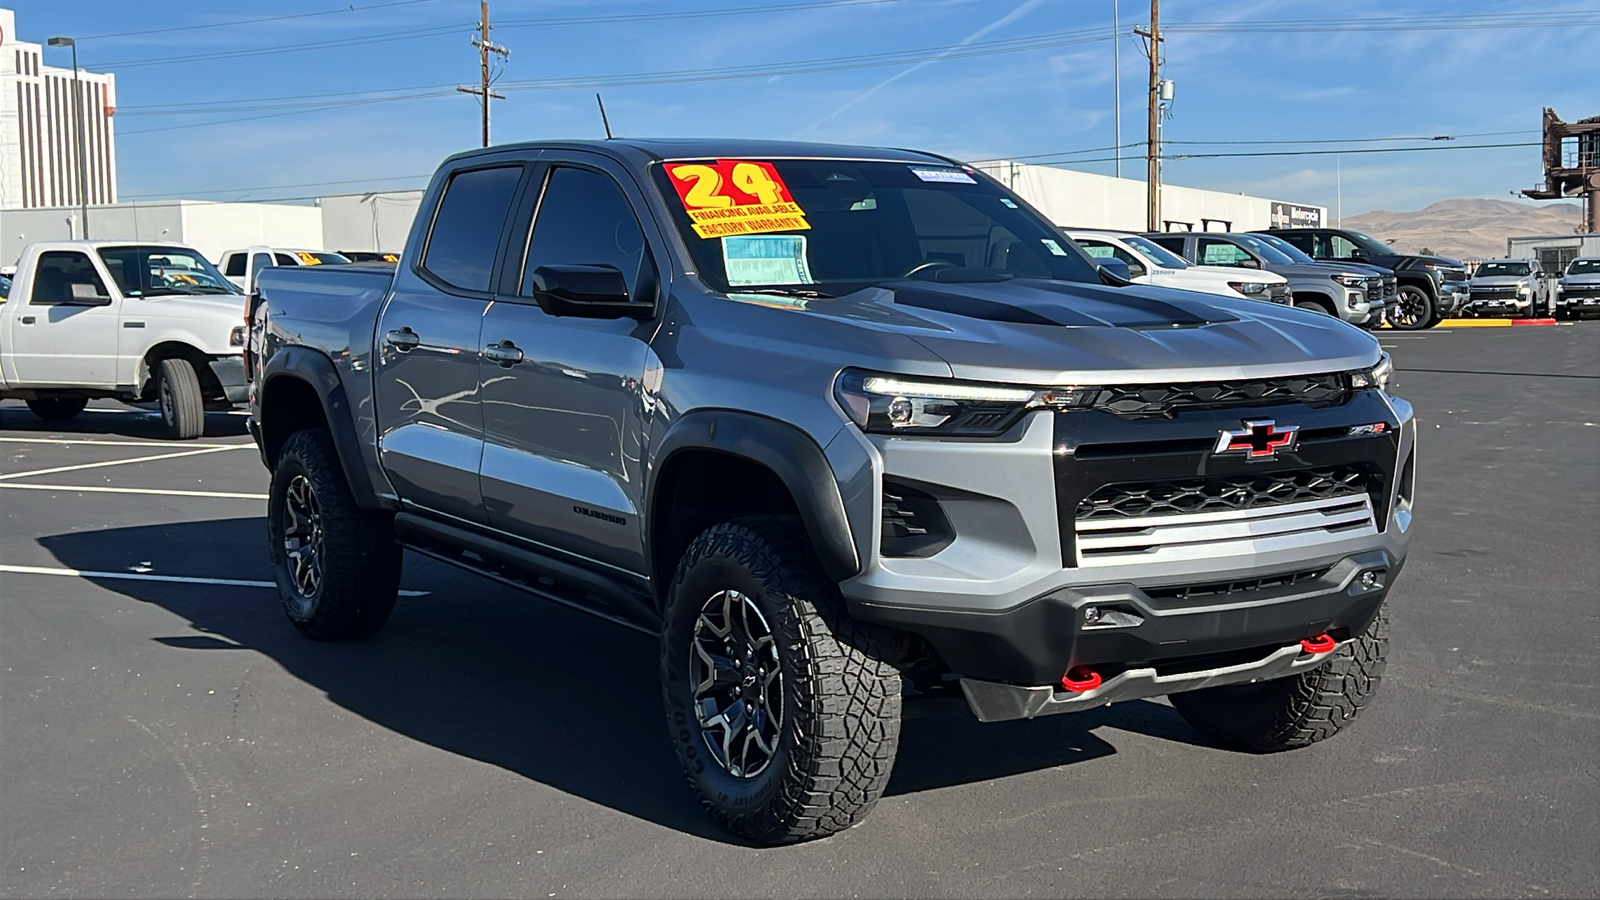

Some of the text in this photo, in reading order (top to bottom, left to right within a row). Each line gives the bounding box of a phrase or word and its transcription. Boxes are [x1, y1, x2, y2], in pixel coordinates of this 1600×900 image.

[671, 162, 783, 208] 24
[692, 204, 800, 221] FINANCING AVAILABLE
[699, 217, 802, 237] FACTORY WARRANTY
